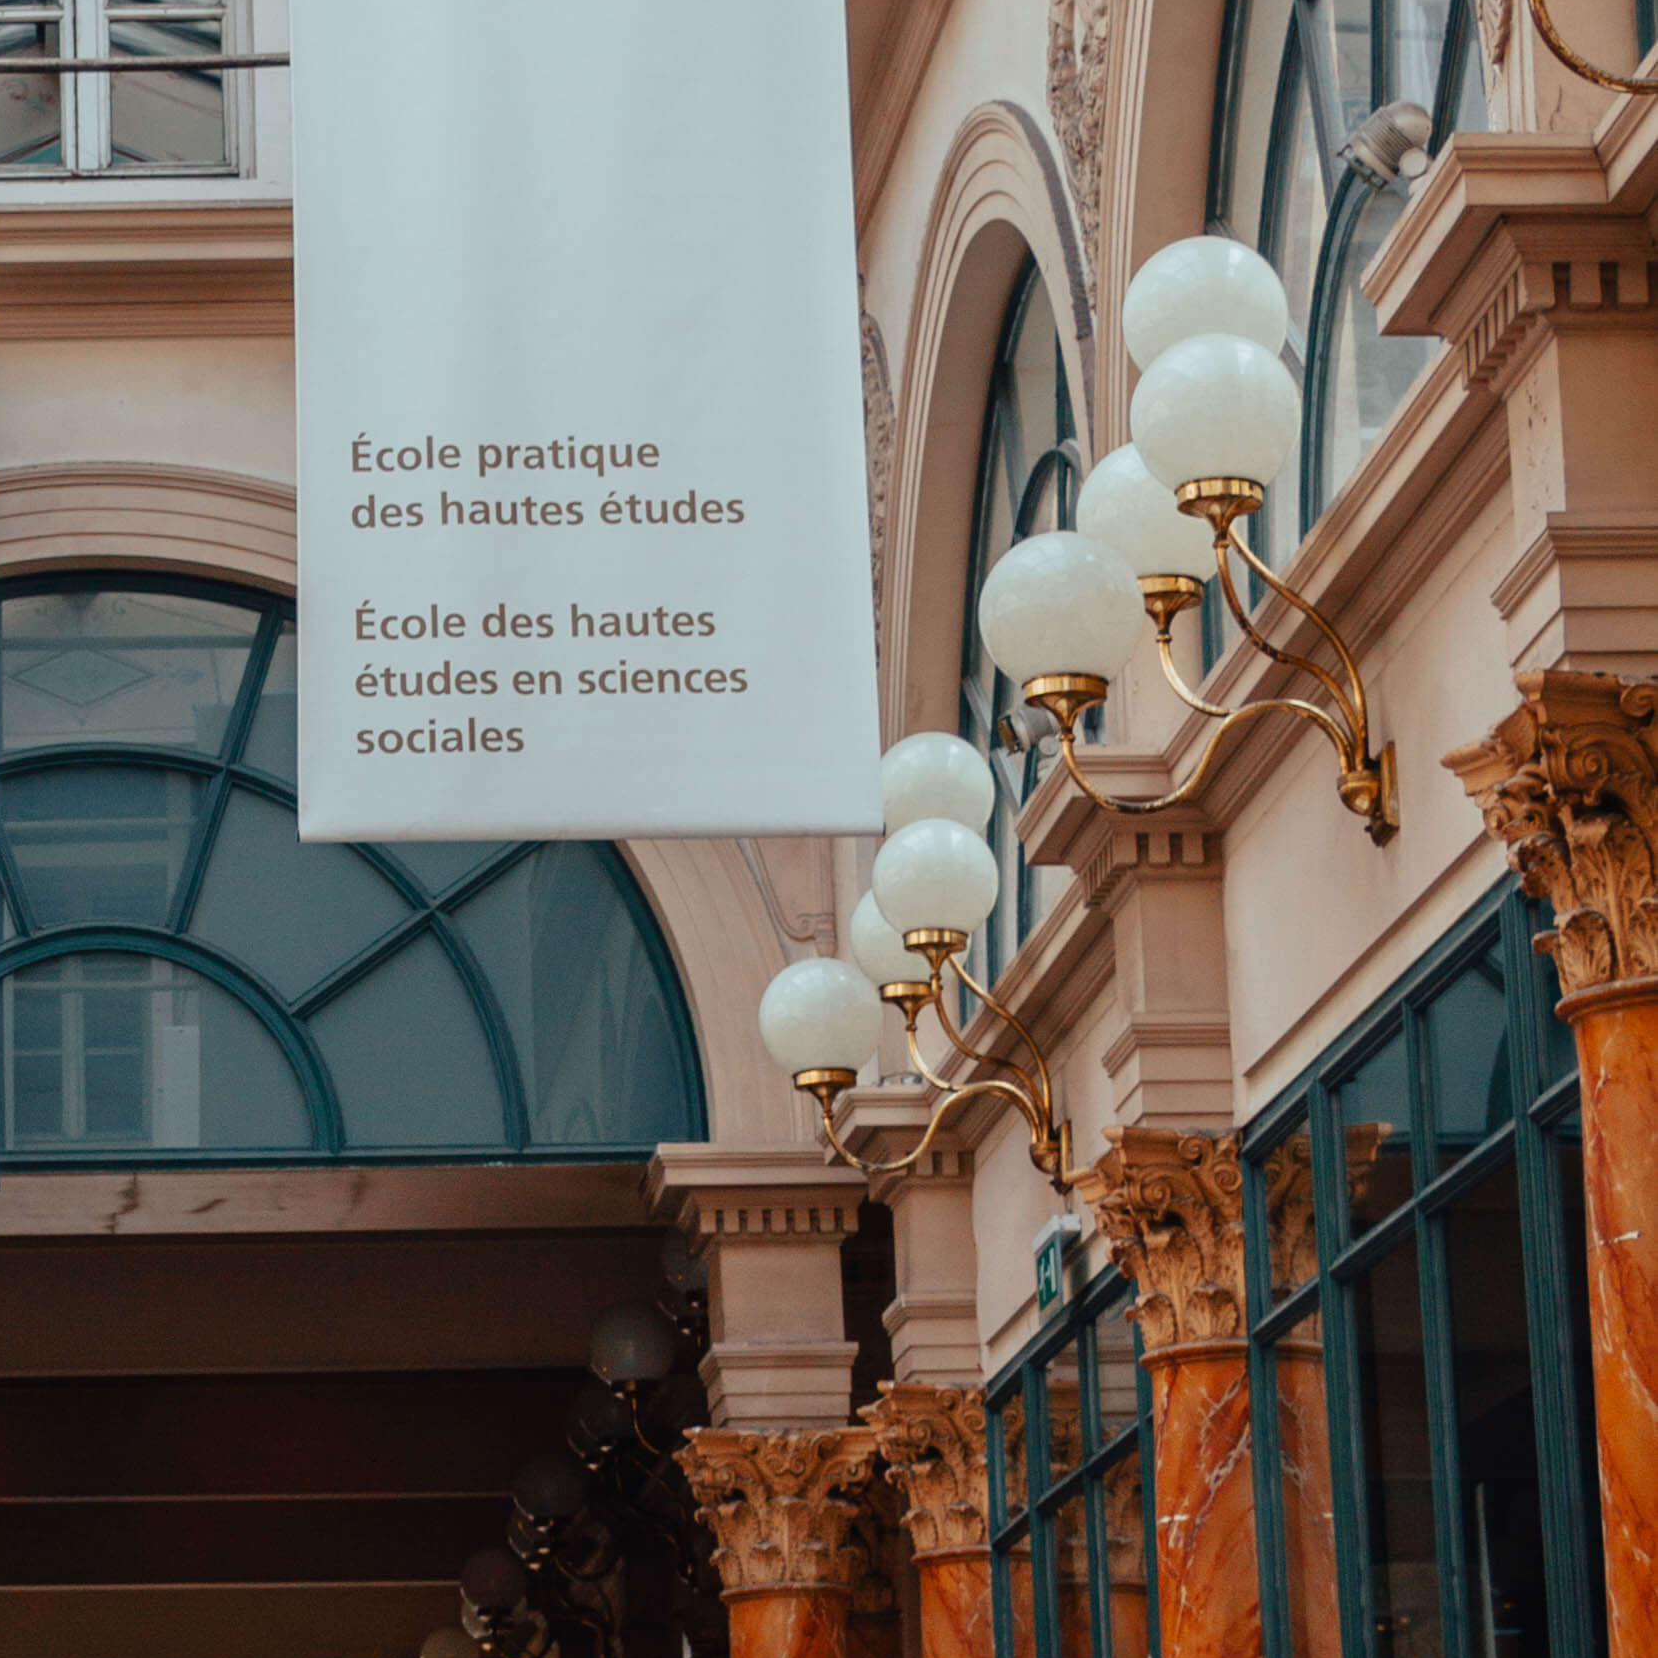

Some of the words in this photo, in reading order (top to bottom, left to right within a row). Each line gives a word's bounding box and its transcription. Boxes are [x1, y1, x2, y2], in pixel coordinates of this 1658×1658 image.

[351, 432, 461, 473] École
[478, 435, 660, 478] pratique
[351, 494, 424, 529] des
[440, 491, 584, 526] hautes
[599, 489, 745, 525] études
[355, 599, 466, 641] École
[482, 602, 554, 639] des
[570, 603, 716, 638] hautes
[355, 660, 499, 698] études
[512, 670, 562, 696] en
[577, 659, 748, 695] sciences
[356, 717, 525, 755] sociales
